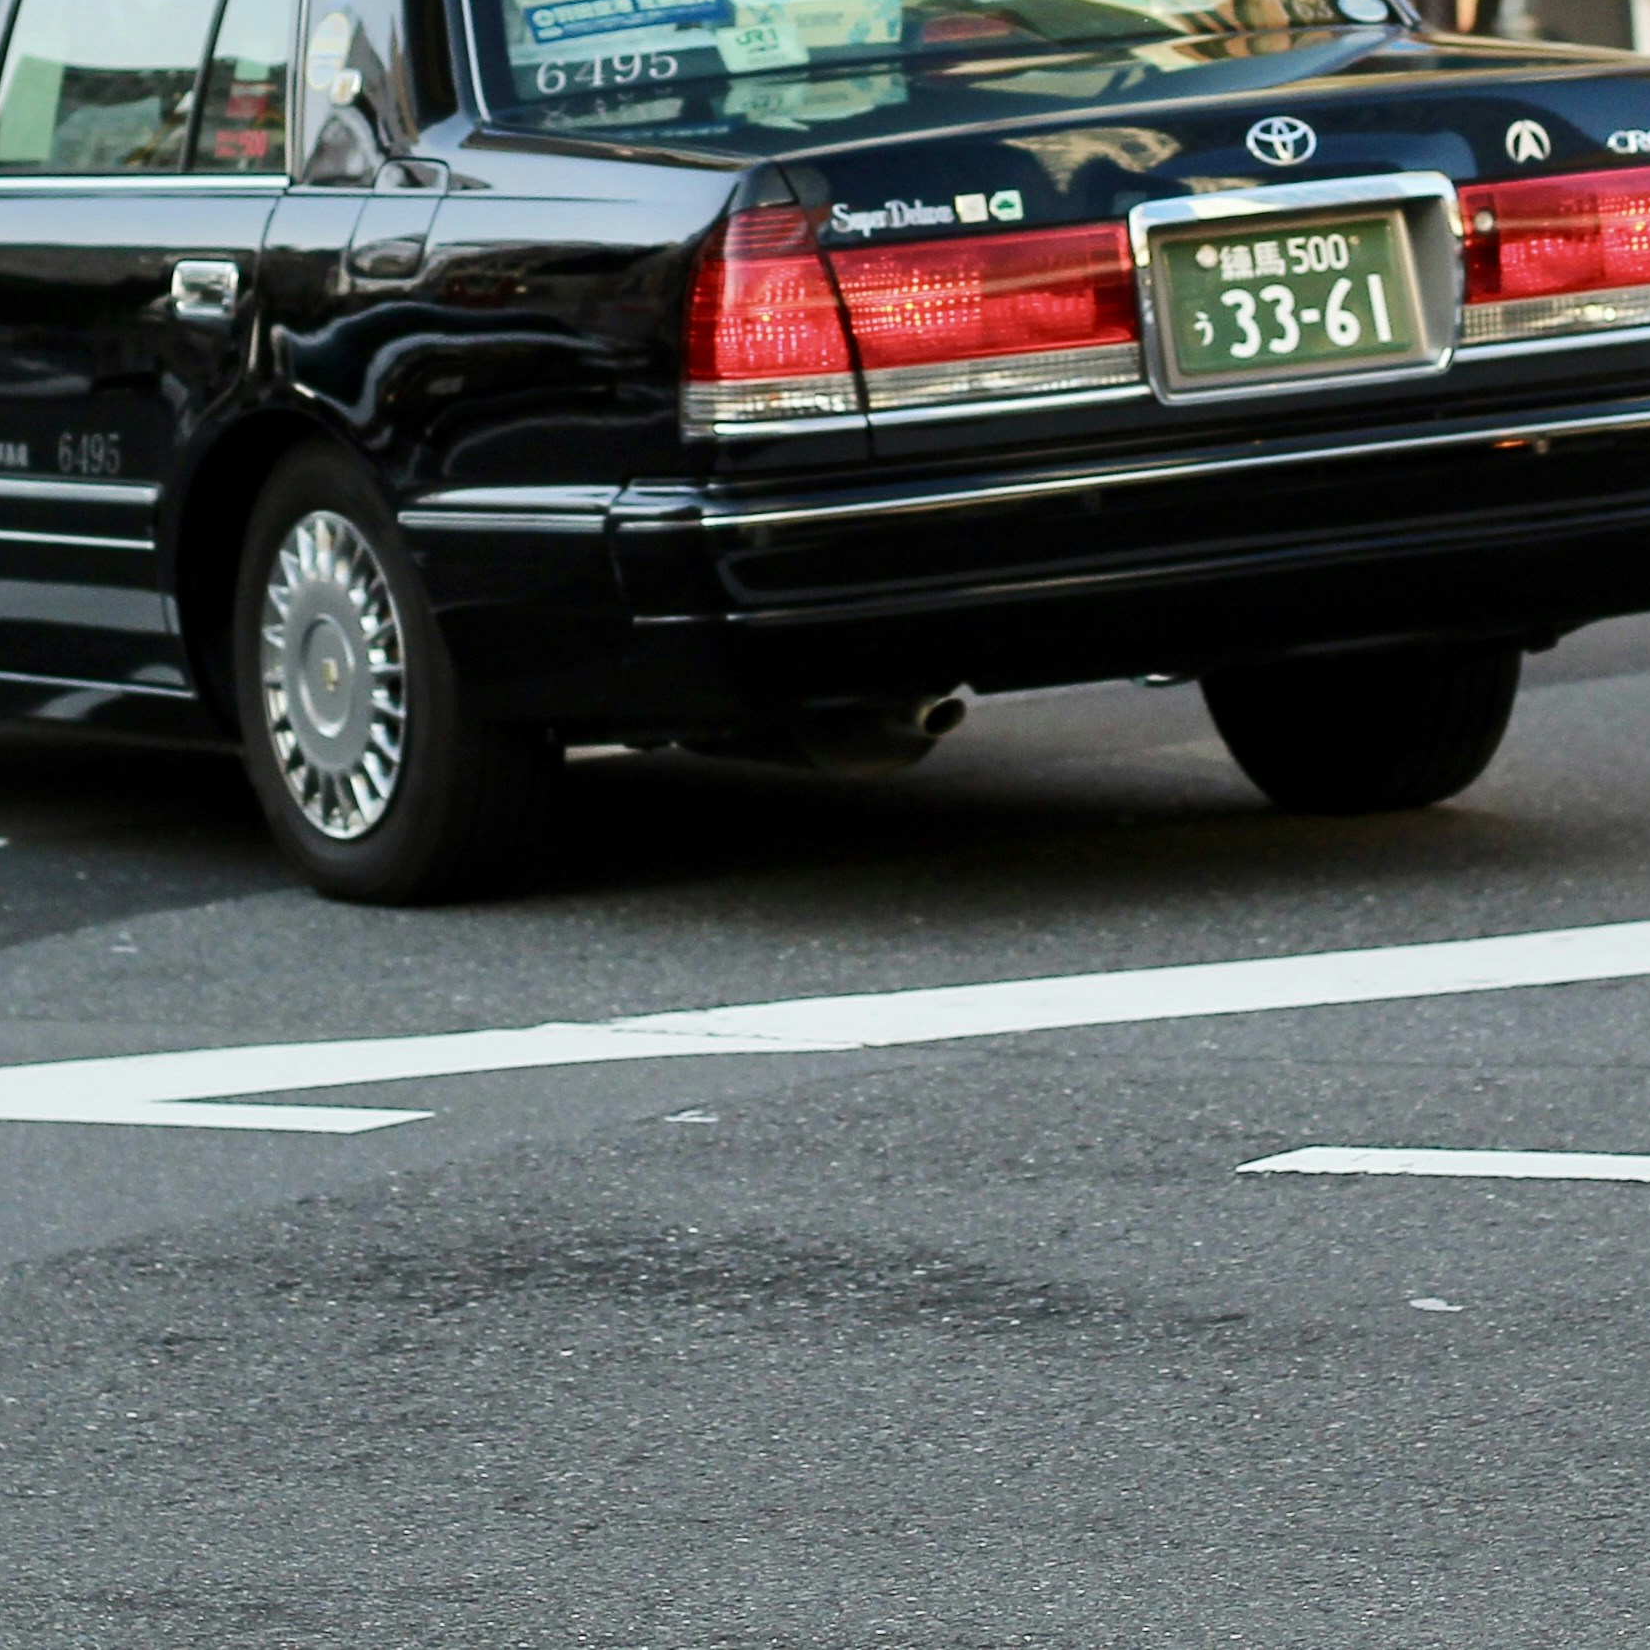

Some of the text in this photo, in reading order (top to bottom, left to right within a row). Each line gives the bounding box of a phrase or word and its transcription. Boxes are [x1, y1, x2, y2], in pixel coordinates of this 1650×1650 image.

[536, 50, 679, 95] 6495
[1219, 233, 1350, 282] 練馬 500
[1193, 273, 1393, 360] う 33-61
[57, 431, 121, 475] 6495
